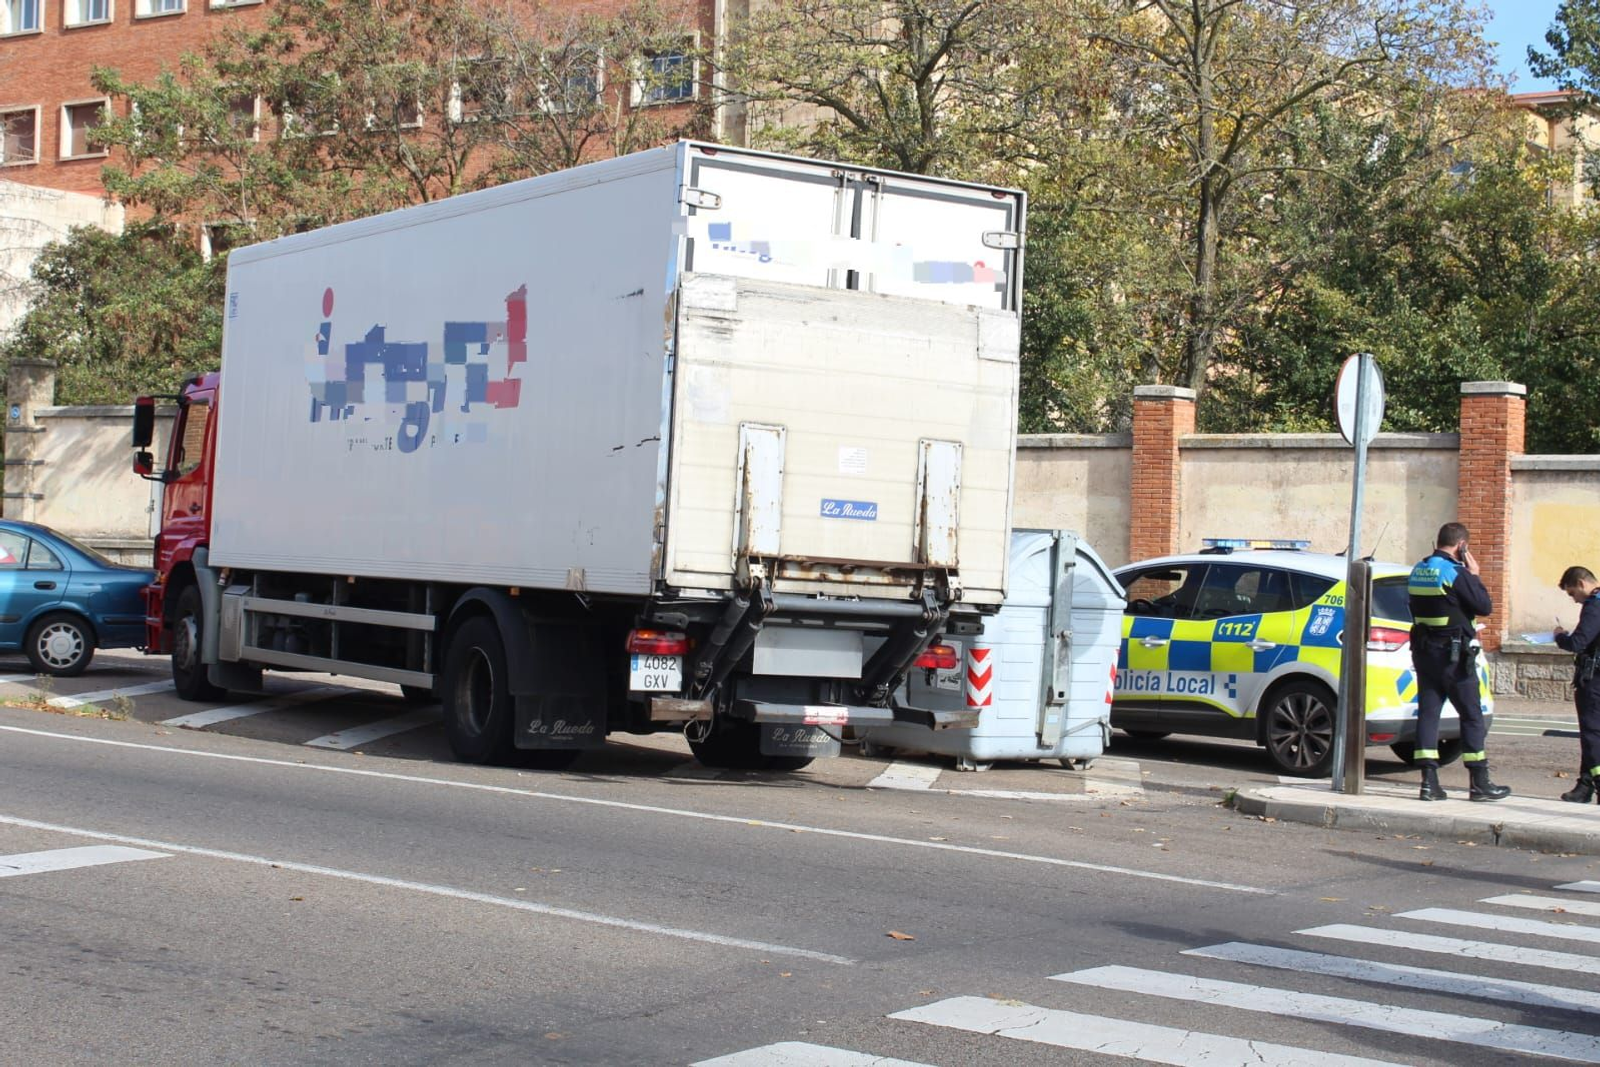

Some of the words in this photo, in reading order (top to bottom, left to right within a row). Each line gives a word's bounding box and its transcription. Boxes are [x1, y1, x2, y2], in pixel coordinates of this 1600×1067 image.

[821, 502, 839, 515] La
[841, 503, 876, 518] Rueda
[1325, 594, 1344, 605] 706
[1225, 622, 1253, 636] 112
[644, 657, 676, 671] 4082
[644, 674, 668, 689] GXV
[1114, 670, 1160, 691] olicía
[1166, 671, 1215, 695] Local
[528, 719, 548, 734] La
[772, 727, 790, 741] La
